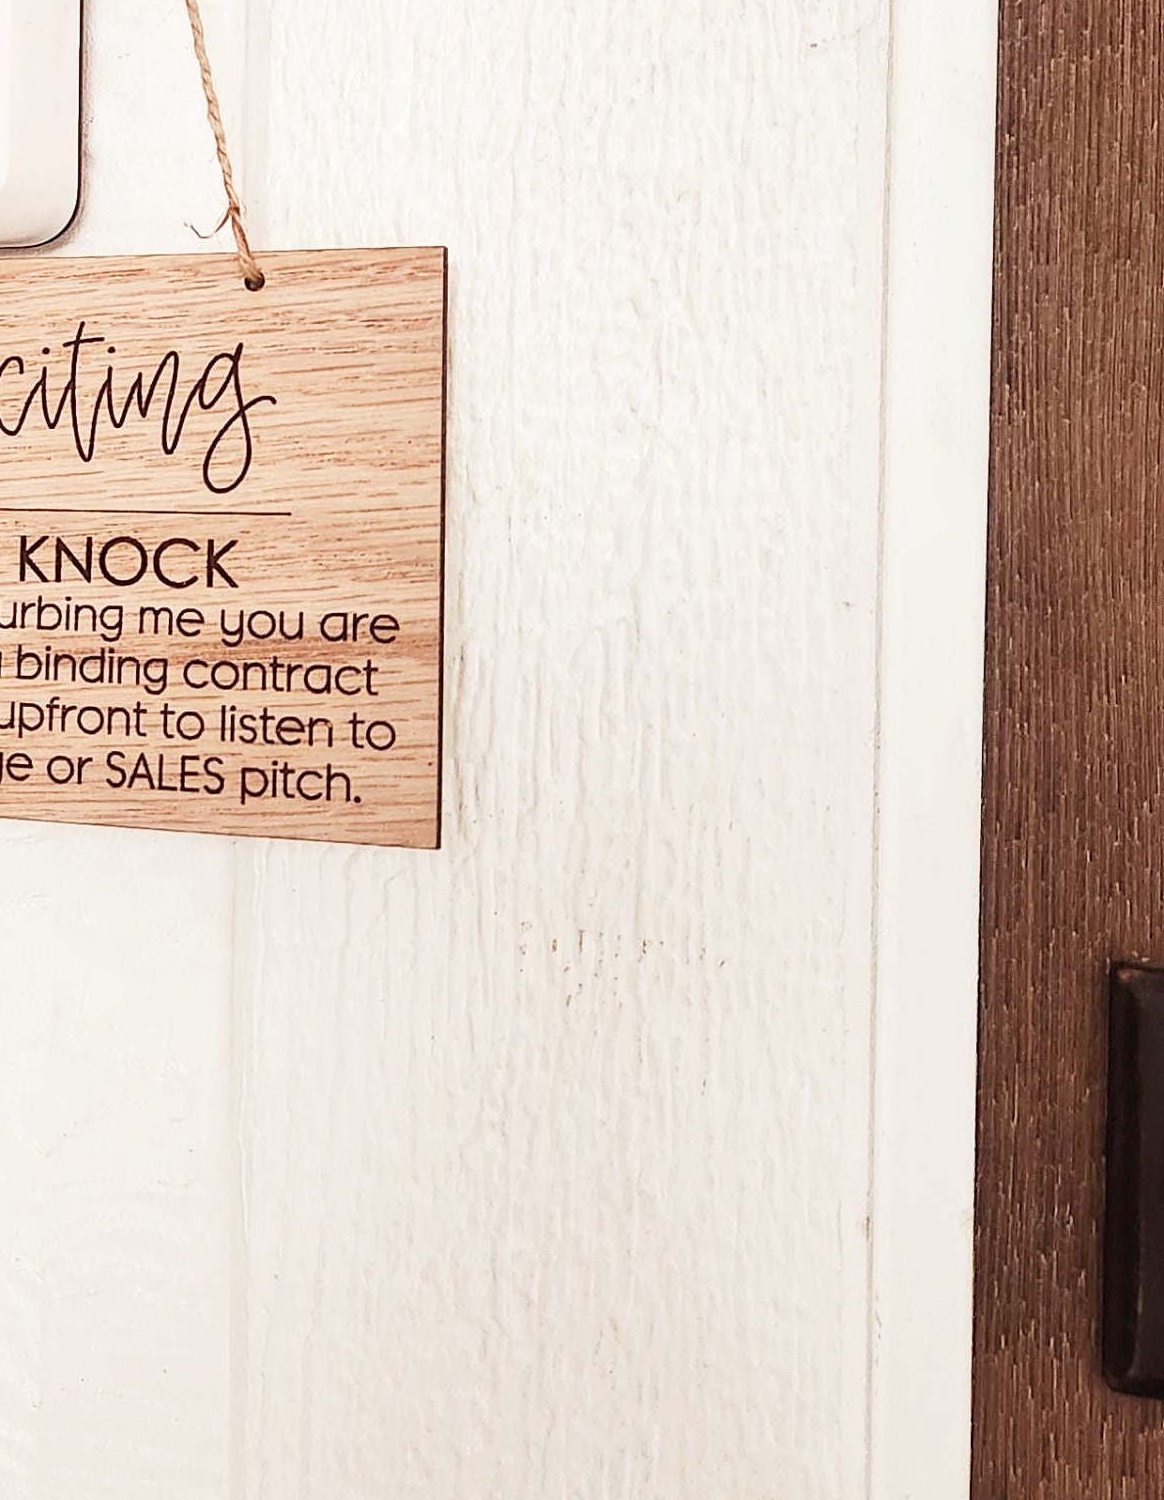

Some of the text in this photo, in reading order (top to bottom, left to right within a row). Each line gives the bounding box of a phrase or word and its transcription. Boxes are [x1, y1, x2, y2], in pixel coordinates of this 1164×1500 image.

[20, 535, 238, 589] KNOCK
[139, 607, 204, 637] me
[221, 610, 303, 647] you
[320, 613, 400, 644] are
[15, 644, 168, 695] binding
[183, 656, 378, 695] contract
[160, 703, 205, 740] to
[221, 705, 333, 747] listen
[348, 712, 396, 751] to
[47, 756, 93, 784] or
[106, 751, 225, 794] SALES
[241, 760, 361, 805] pitch.
